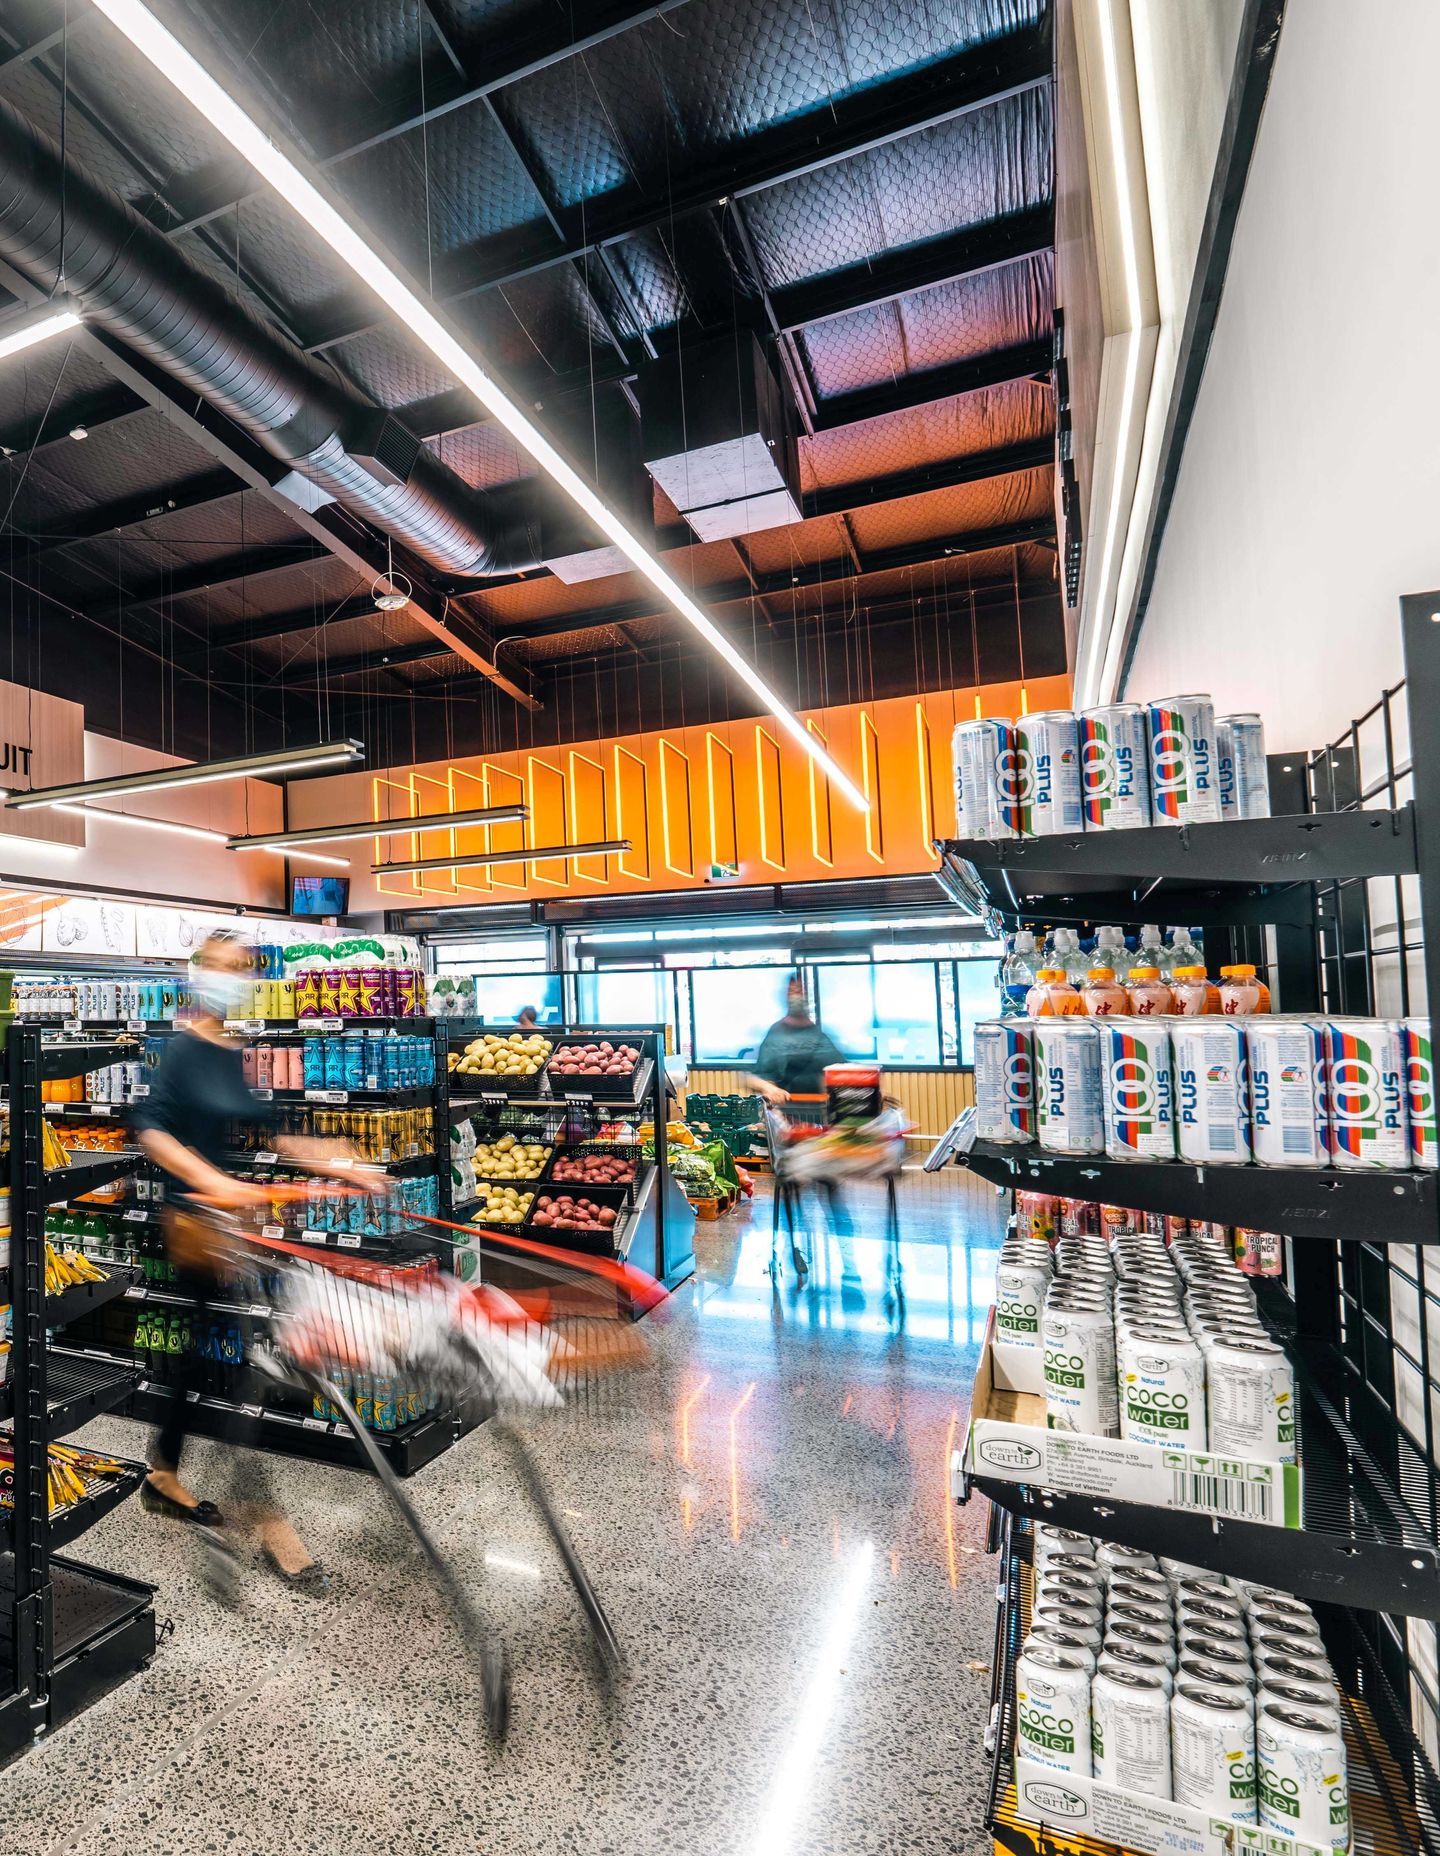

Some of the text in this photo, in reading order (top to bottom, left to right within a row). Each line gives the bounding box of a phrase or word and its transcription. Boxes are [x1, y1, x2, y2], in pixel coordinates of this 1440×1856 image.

[1081, 738, 1116, 801] 100
[1115, 746, 1134, 797] PLUS
[1151, 729, 1194, 801] 100
[1193, 738, 1211, 790] PLUS
[1036, 754, 1052, 804] PLUS
[1218, 757, 1234, 805] PLUS
[1003, 1052, 1034, 1115] 100
[1048, 1066, 1065, 1117] PLUS
[1110, 1057, 1156, 1127] 100
[1156, 1069, 1171, 1123] PLUS
[1331, 1058, 1382, 1132] 100
[1382, 1072, 1402, 1130] PLUS
[1180, 1069, 1199, 1125] PLUS
[1253, 1070, 1271, 1127] PLUS
[1246, 1233, 1278, 1246] TROPICAL
[1251, 1243, 1276, 1254] PUNCH
[998, 1317, 1037, 1332] water
[1044, 1350, 1084, 1370] oco
[1141, 1376, 1166, 1386] Natural
[1060, 1398, 1081, 1407] WATER
[1126, 1385, 1188, 1410] coco
[1127, 1406, 1189, 1429] water
[985, 1443, 1011, 1453] down
[1077, 1446, 1100, 1455] EARTH
[1101, 1450, 1125, 1459] FOODS
[1128, 1432, 1186, 1450] COCONUT WATER
[989, 1451, 1030, 1466] earth
[1125, 1460, 1154, 1469] Auckland
[1048, 1478, 1072, 1488] Product
[1083, 1483, 1110, 1493] Vietnam
[1030, 1697, 1052, 1710] Natural
[1019, 1702, 1074, 1734] coco
[1020, 1727, 1074, 1753] water
[1259, 1762, 1300, 1796] oco
[1030, 1786, 1056, 1798] down
[1260, 1786, 1300, 1816] ater
[1034, 1795, 1076, 1813] earth
[1092, 1792, 1113, 1803] DOWN
[1123, 1801, 1147, 1813] EARTH
[1147, 1807, 1173, 1820] FOODS
[1173, 1816, 1187, 1824] LTD
[1094, 1828, 1157, 1852] Product of Vietnam
[1172, 1822, 1201, 1835] Auckland
[1267, 1820, 1296, 1837] WATER
